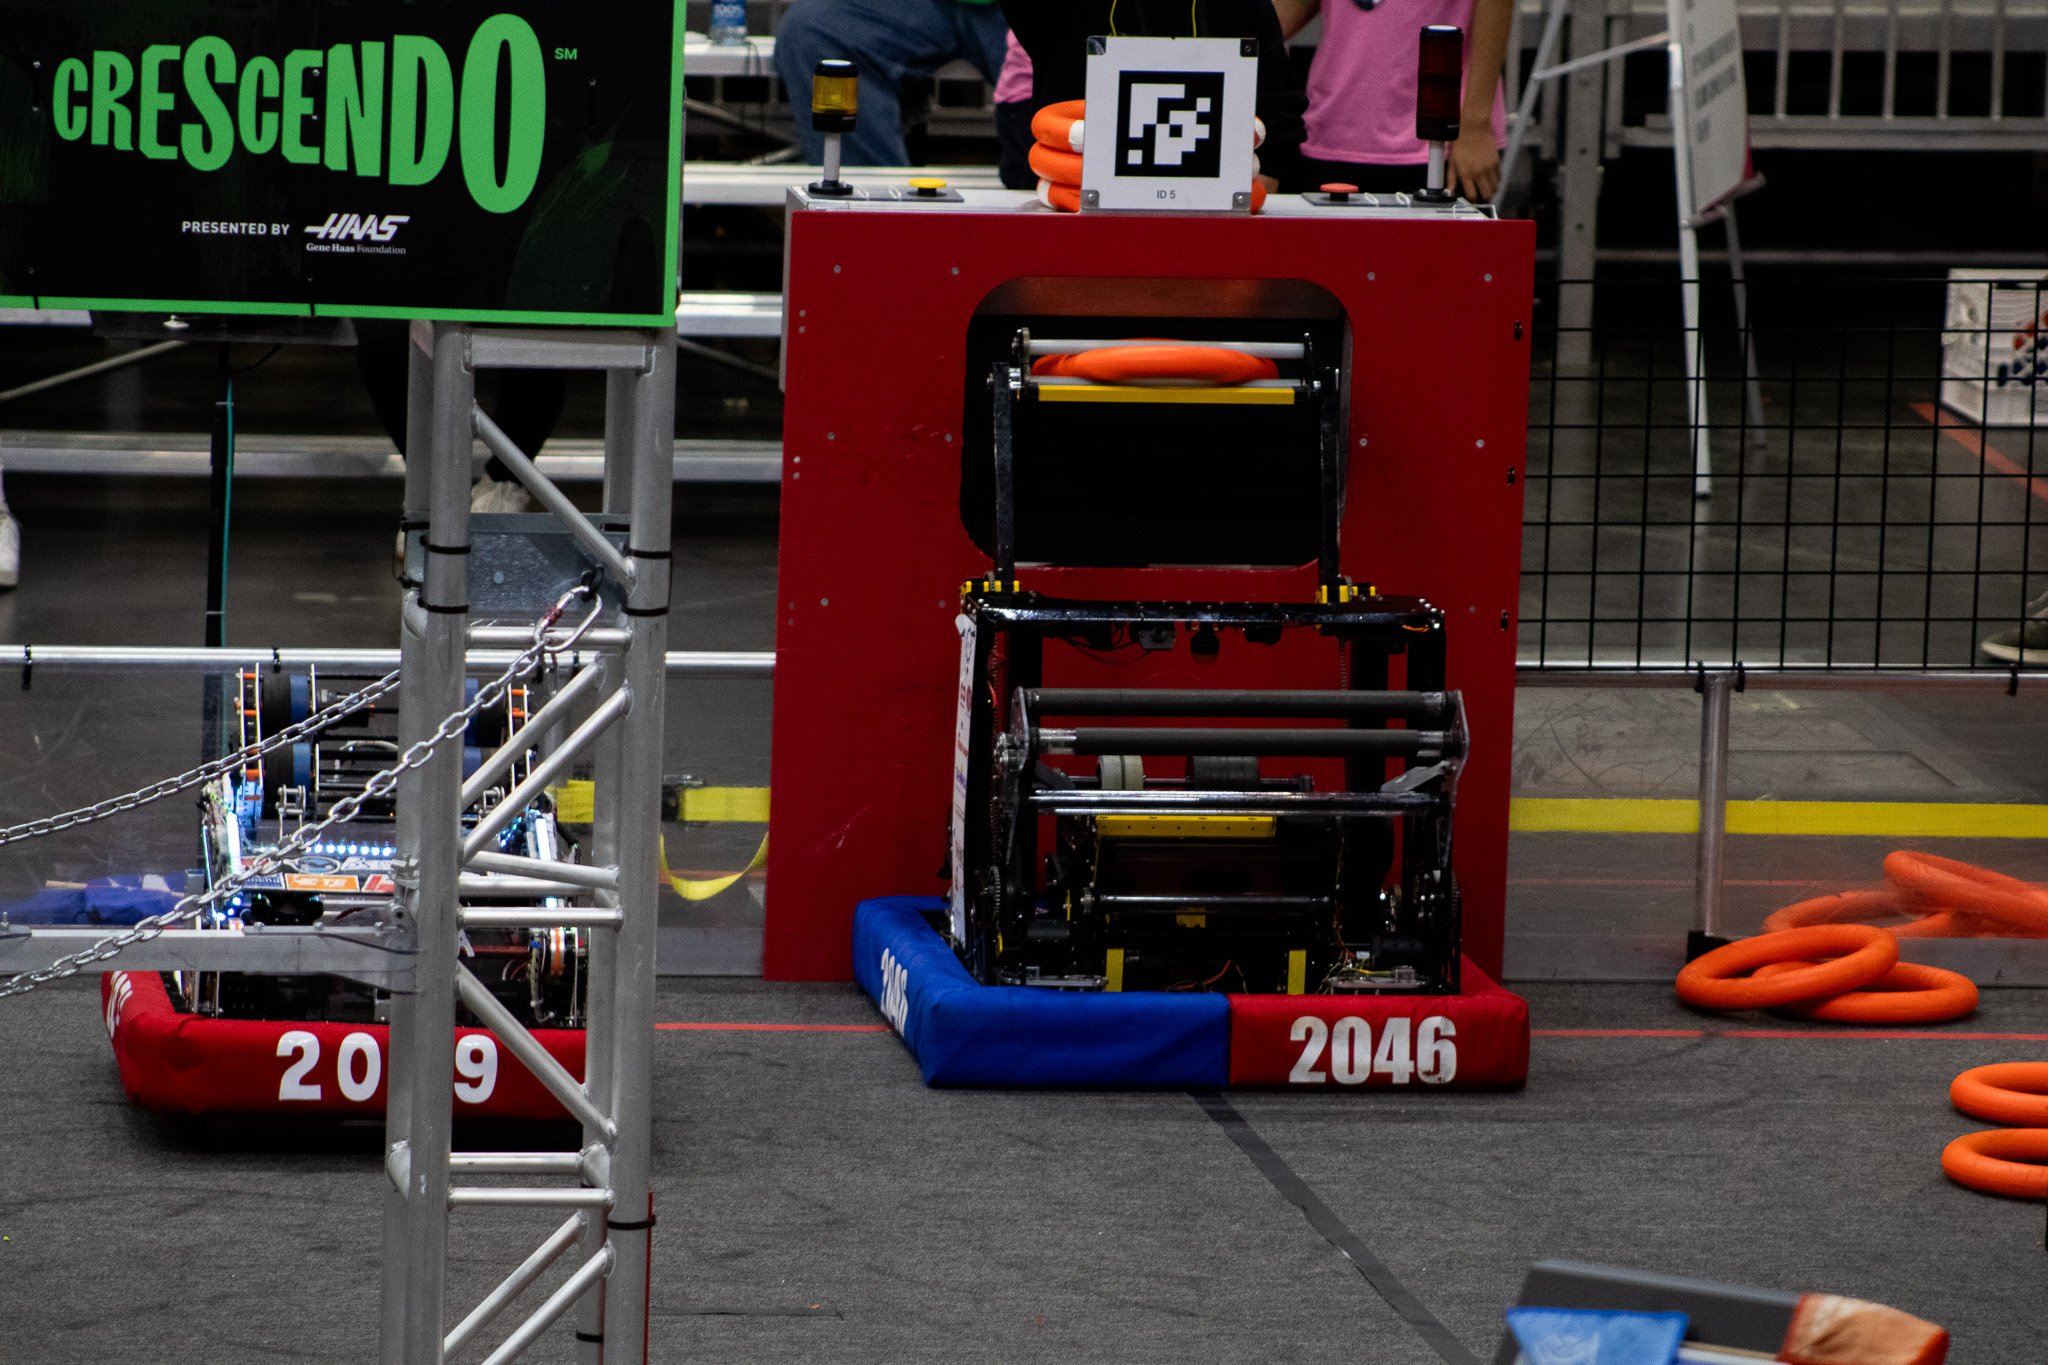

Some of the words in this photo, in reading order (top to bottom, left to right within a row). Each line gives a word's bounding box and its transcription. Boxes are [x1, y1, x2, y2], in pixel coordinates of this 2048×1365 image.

[53, 13, 546, 213] CRESCENDO
[1156, 190, 1167, 199] ID
[1170, 190, 1176, 199] 5
[182, 221, 267, 235] PRESENTED
[271, 224, 290, 236] BY
[304, 213, 410, 240] HAAS
[306, 243, 331, 252] Gene
[332, 244, 355, 253] Haas
[357, 244, 406, 255] Foundation
[1289, 1015, 1457, 1084] 2046
[276, 1031, 499, 1103] 209
